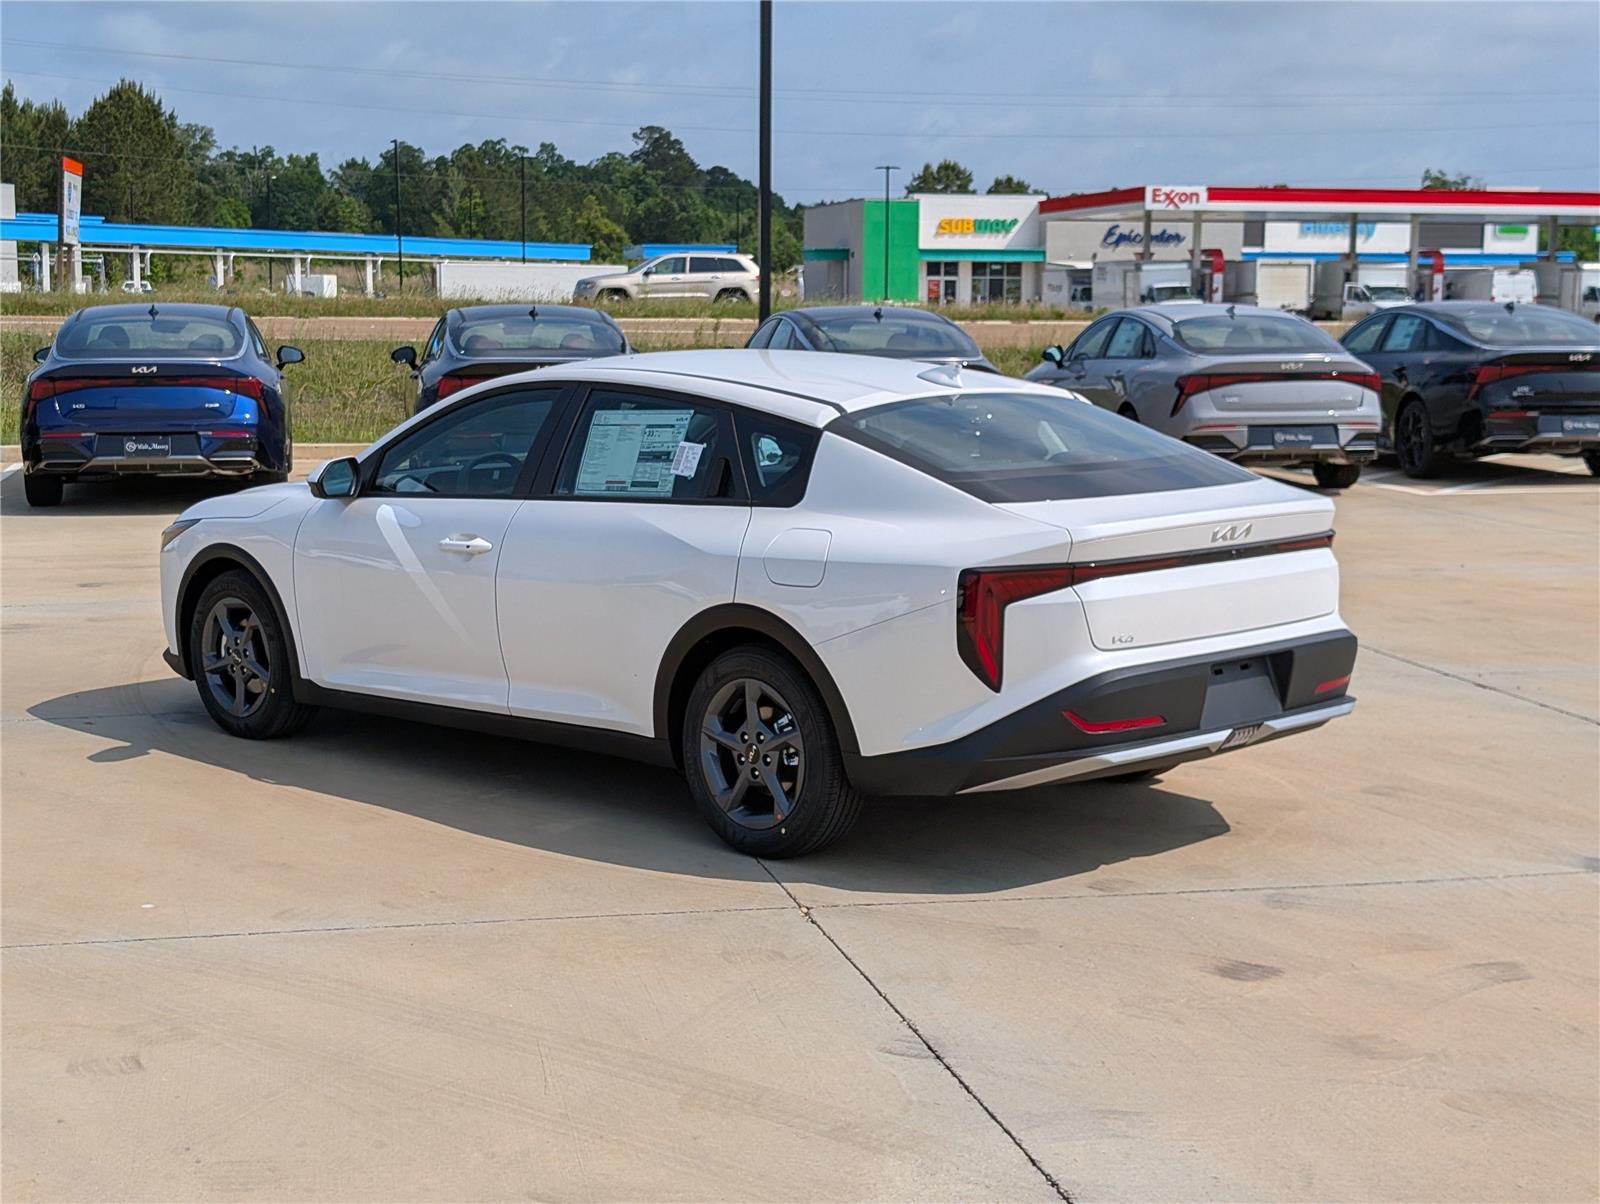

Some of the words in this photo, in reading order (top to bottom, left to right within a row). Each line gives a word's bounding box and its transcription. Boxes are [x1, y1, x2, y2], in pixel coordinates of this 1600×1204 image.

[1151, 188, 1200, 209] Exxon
[938, 217, 1019, 235] SUBWAY
[1103, 224, 1186, 247] Epicnter
[131, 366, 158, 374] KIA
[1211, 523, 1253, 544] KIA
